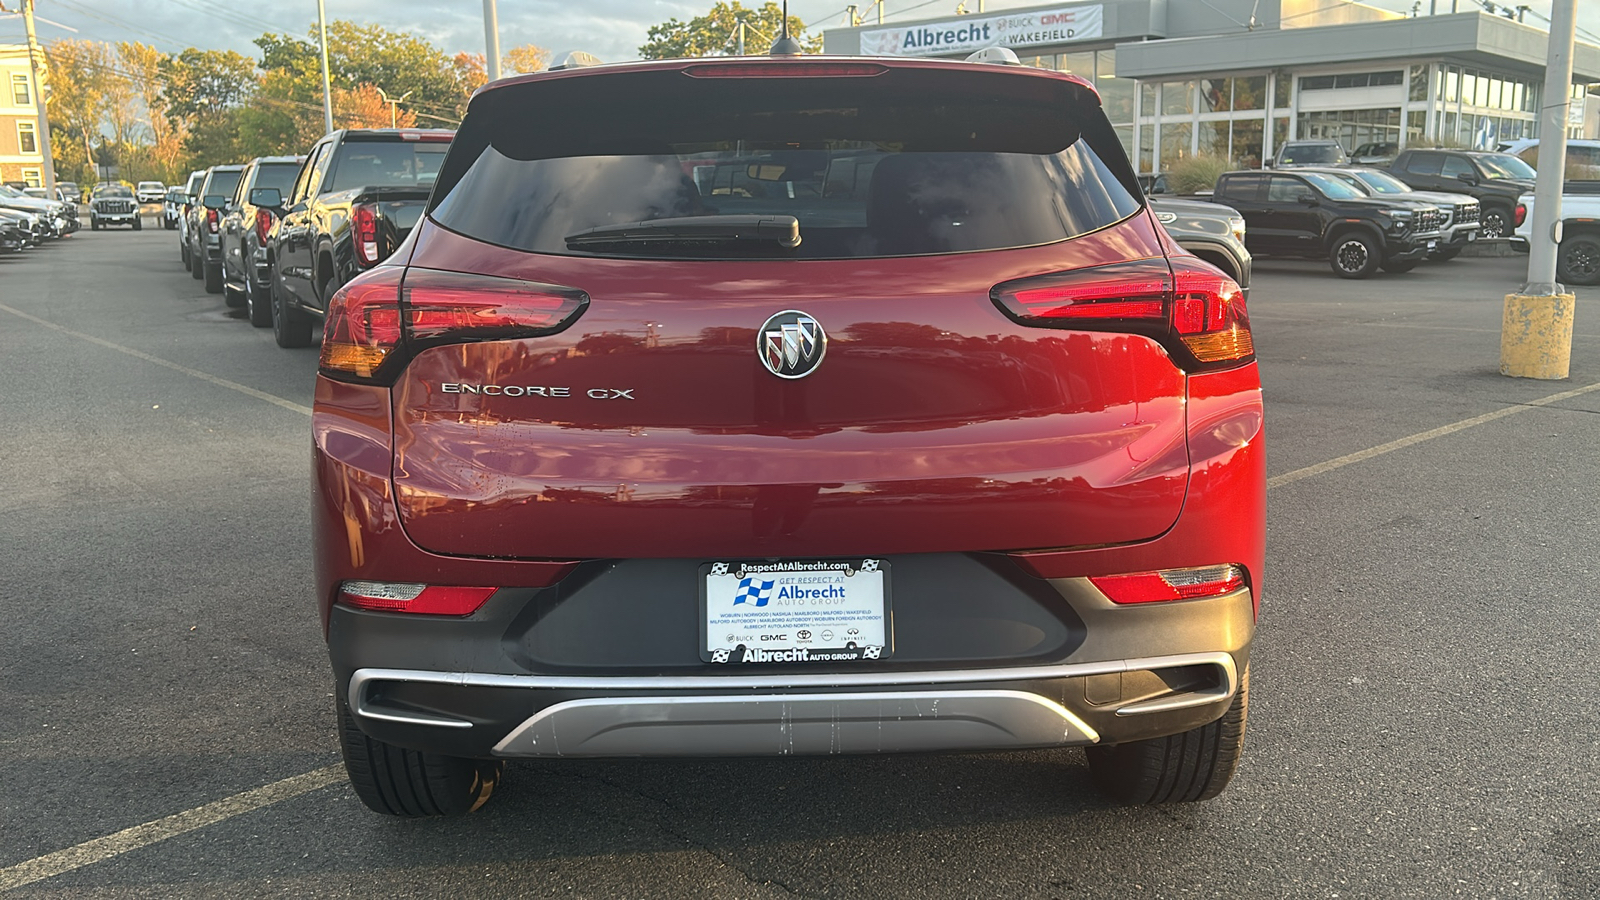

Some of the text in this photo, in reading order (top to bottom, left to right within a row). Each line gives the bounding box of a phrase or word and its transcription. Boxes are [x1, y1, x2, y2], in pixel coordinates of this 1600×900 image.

[1008, 17, 1033, 29] BUICK
[1040, 13, 1076, 25] GMC
[904, 23, 990, 48] Albrecht
[1008, 28, 1075, 44] WAKEFIELD
[441, 382, 635, 400] ENCORE GX
[741, 562, 849, 573] RespectAtAlbrecht.com
[798, 576, 832, 584] RESPECT
[778, 585, 845, 599] Albrecht
[742, 648, 808, 662] Albrecht
[831, 653, 858, 661] GROUP
